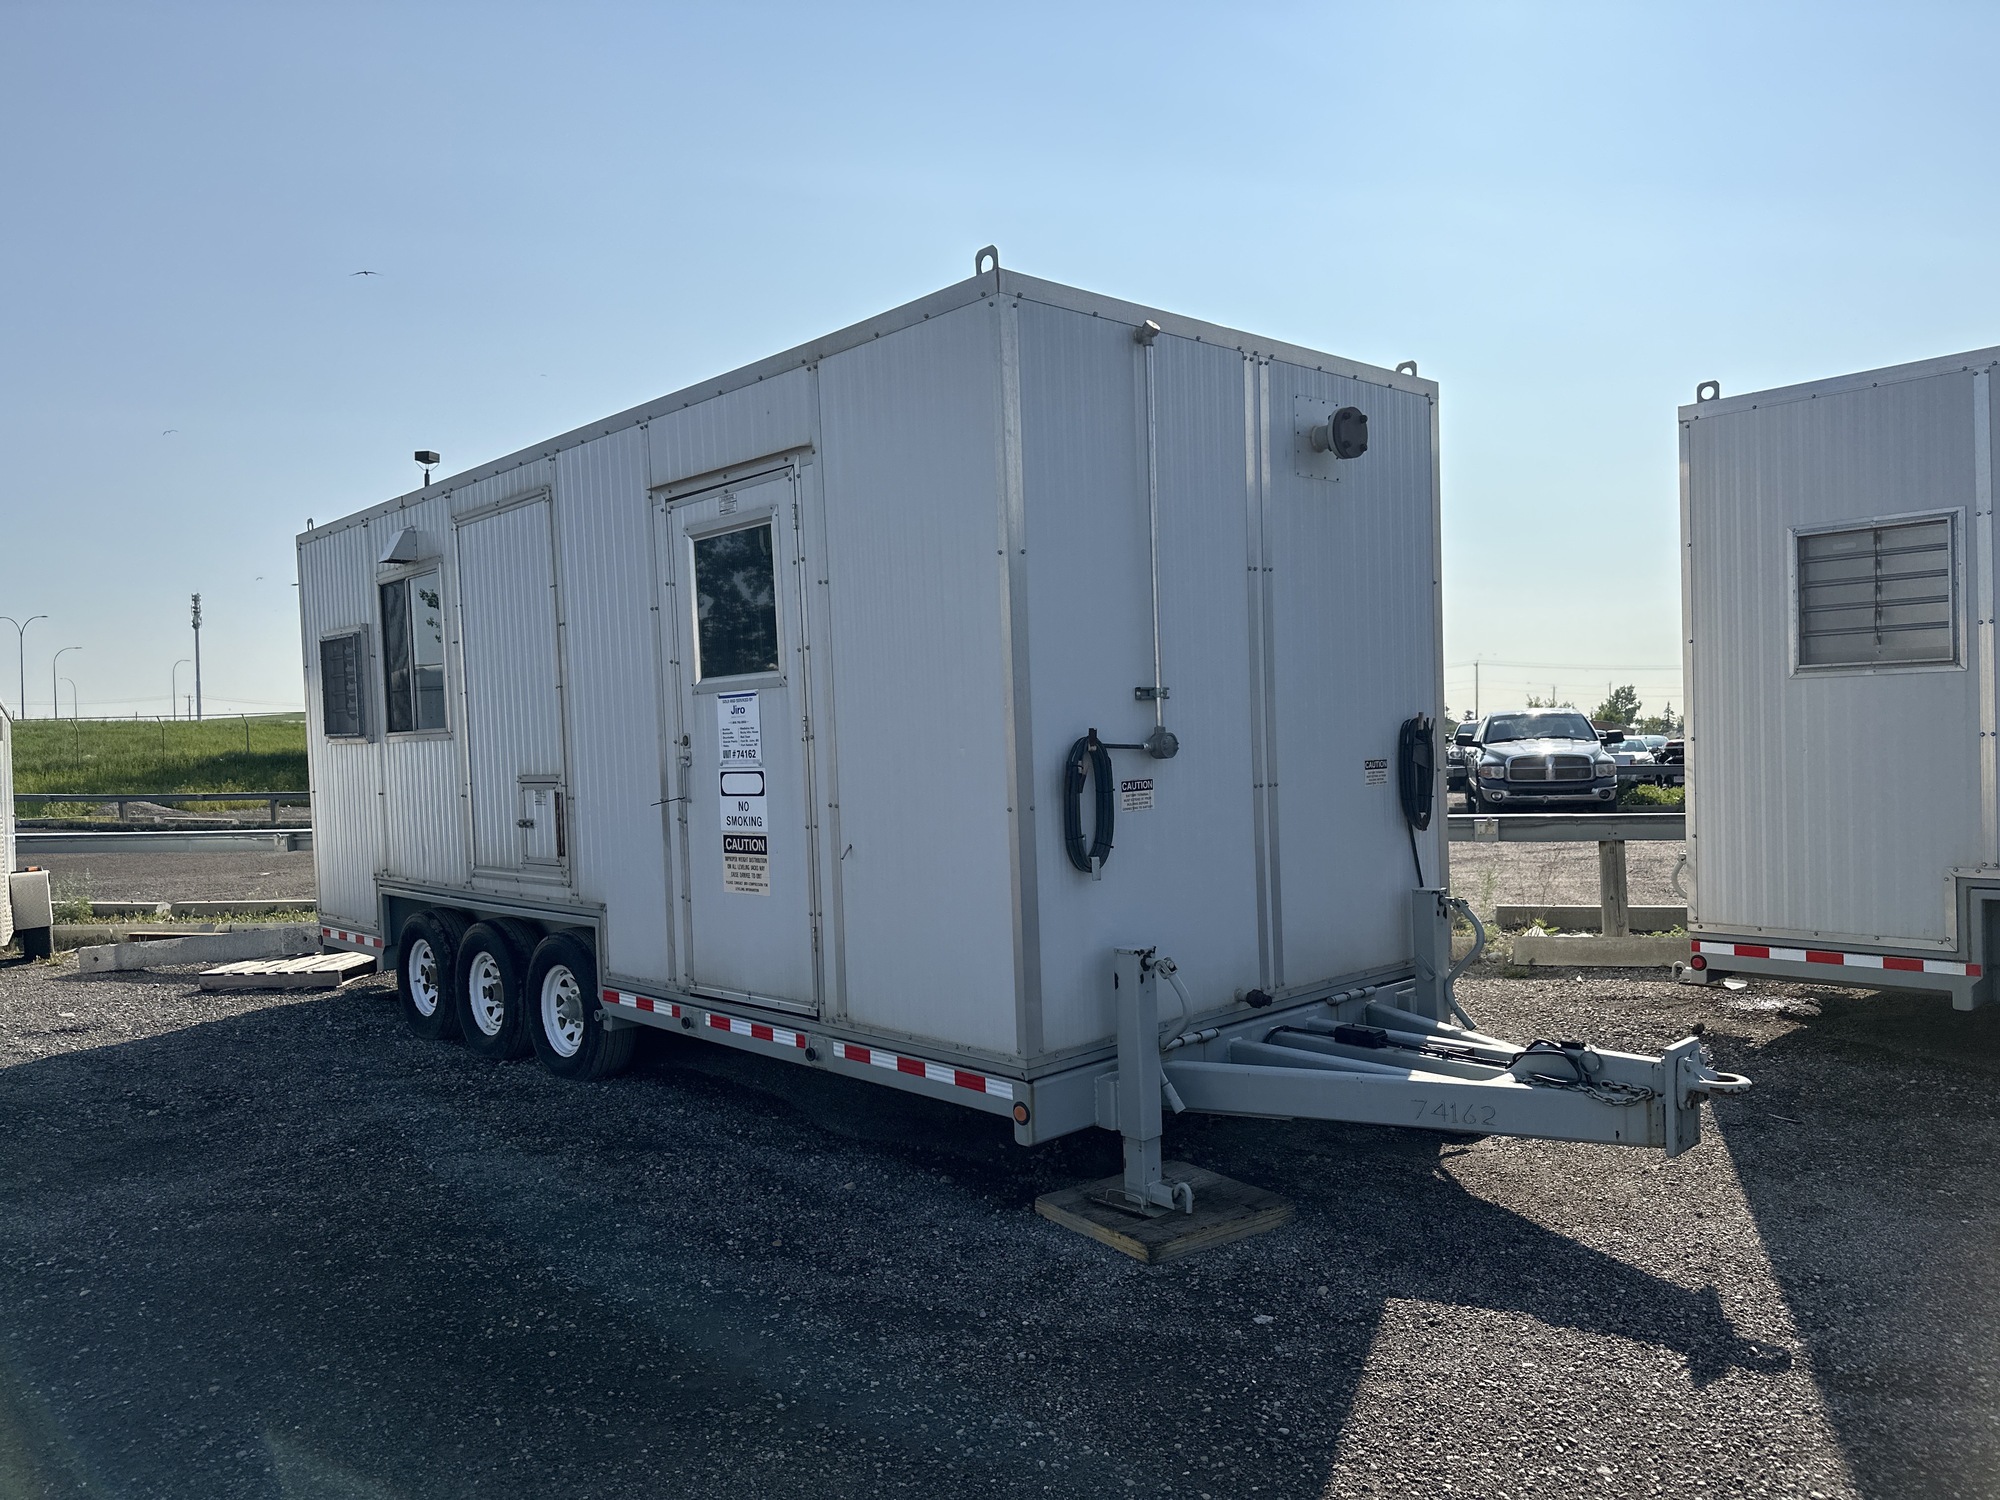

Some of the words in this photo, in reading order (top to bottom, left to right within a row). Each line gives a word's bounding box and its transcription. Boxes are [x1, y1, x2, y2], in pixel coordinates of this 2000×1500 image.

[731, 705, 745, 714] Jiro
[1365, 760, 1387, 769] CAUTION
[1122, 780, 1153, 791] CAUTION
[738, 801, 749, 812] NO
[726, 816, 762, 827] SMOKING
[725, 838, 765, 852] CAUTION
[1410, 1099, 1497, 1126] 74162
